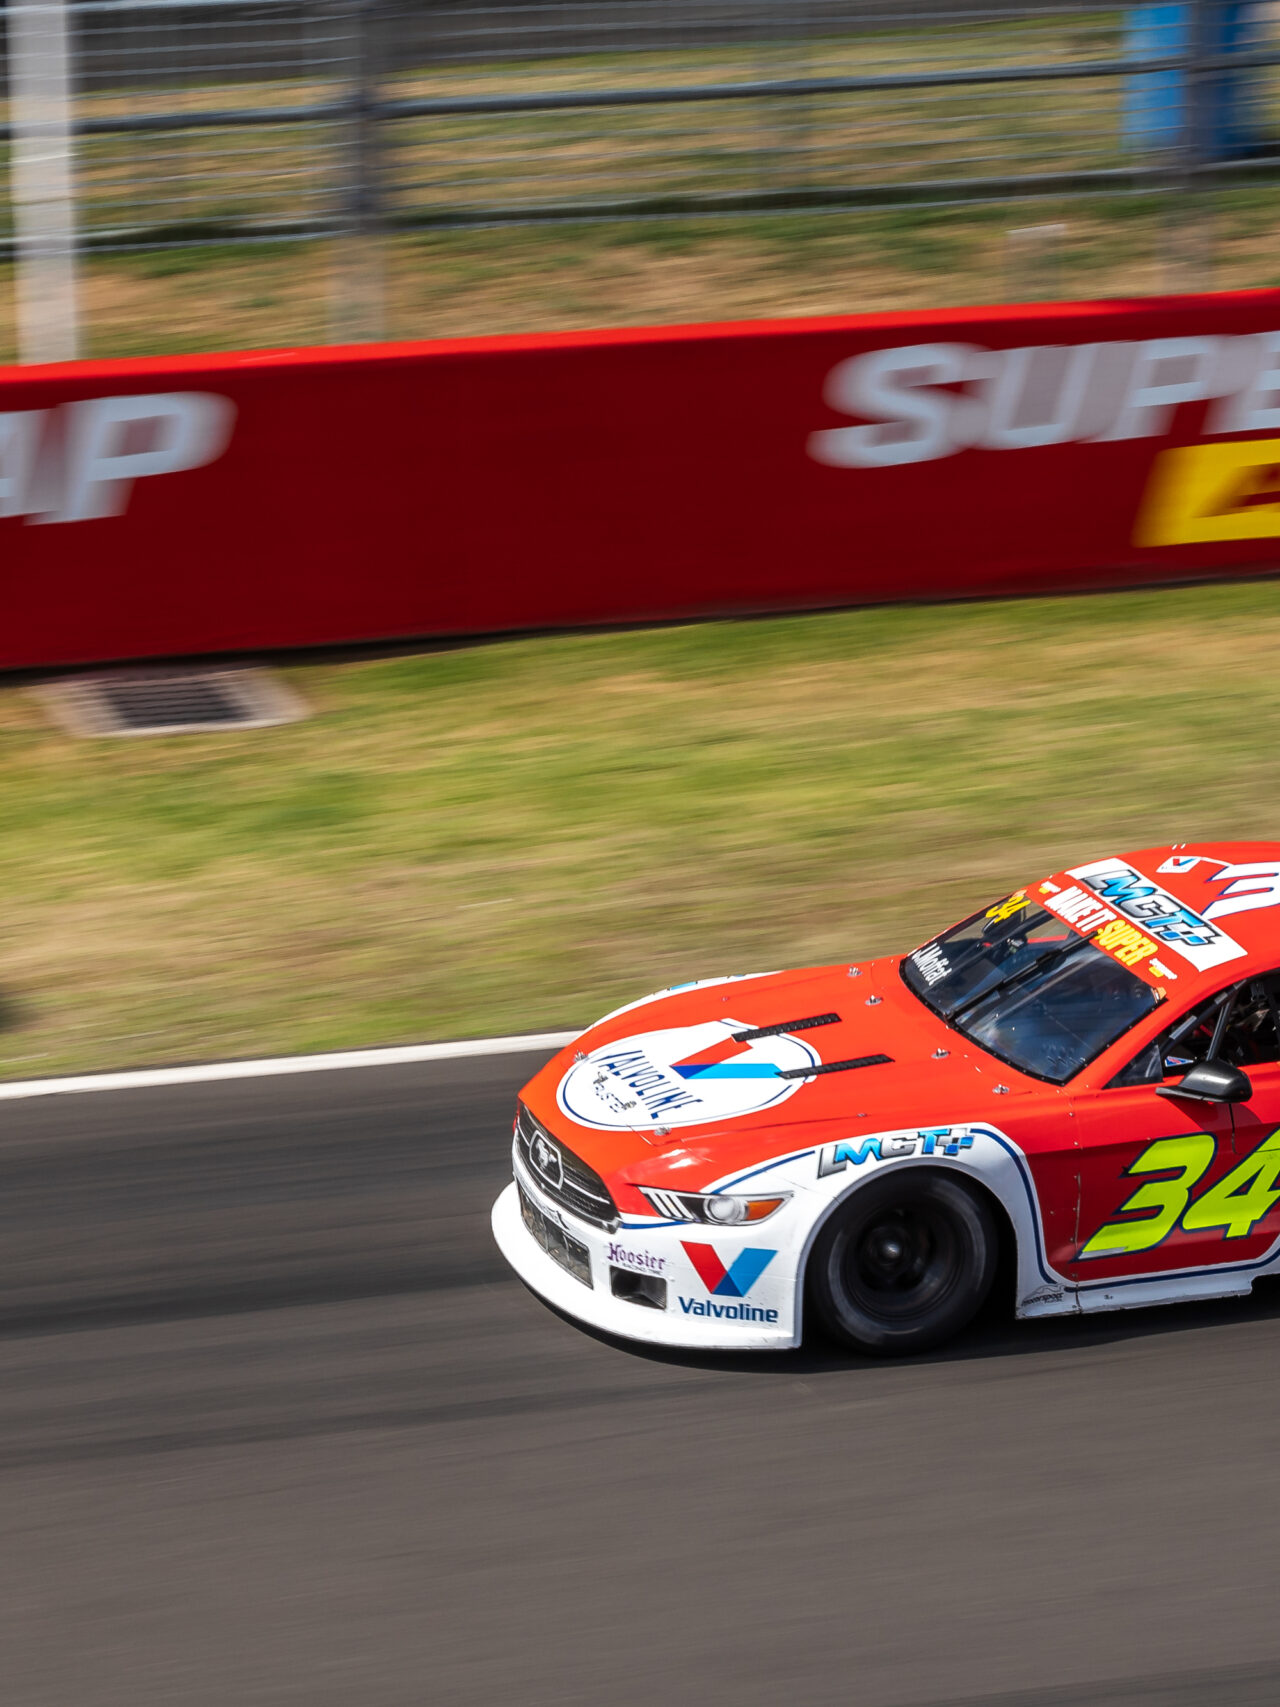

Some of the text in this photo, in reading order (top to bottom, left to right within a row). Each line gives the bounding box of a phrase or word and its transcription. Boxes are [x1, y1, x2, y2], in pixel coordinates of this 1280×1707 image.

[1043, 885, 1104, 924] MAKE
[1095, 919, 1160, 967] SUPER
[590, 1050, 703, 1119] VALVOLINE
[607, 1242, 666, 1270] Hoosier
[678, 1296, 778, 1323] Valvoline
